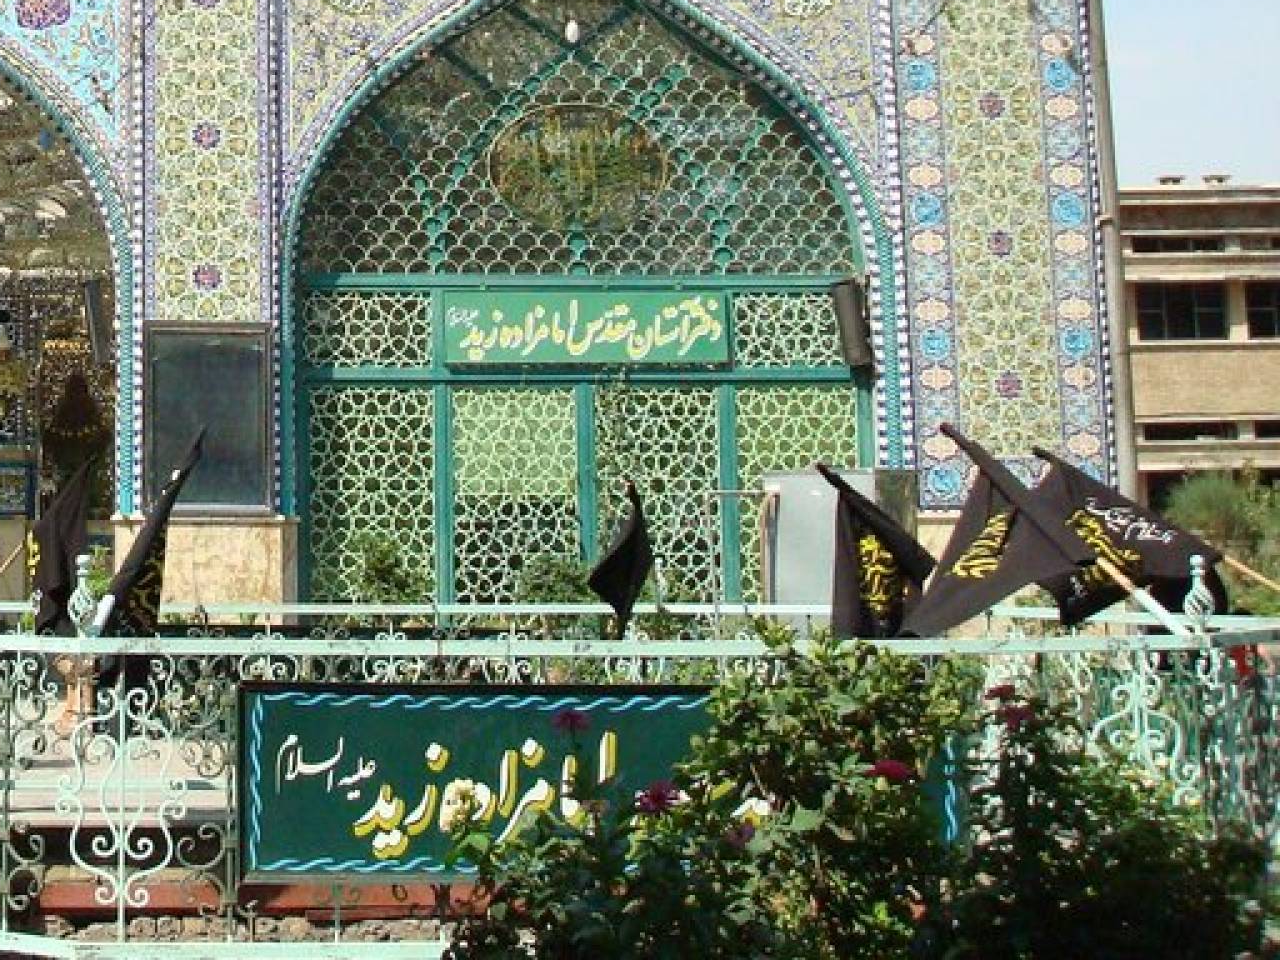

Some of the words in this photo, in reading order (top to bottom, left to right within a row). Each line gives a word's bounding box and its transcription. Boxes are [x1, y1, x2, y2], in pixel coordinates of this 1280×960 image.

[459, 309, 504, 361] زید
[499, 299, 579, 357] امامزاده
[567, 304, 637, 356] مقدس
[352, 742, 450, 859] زید
